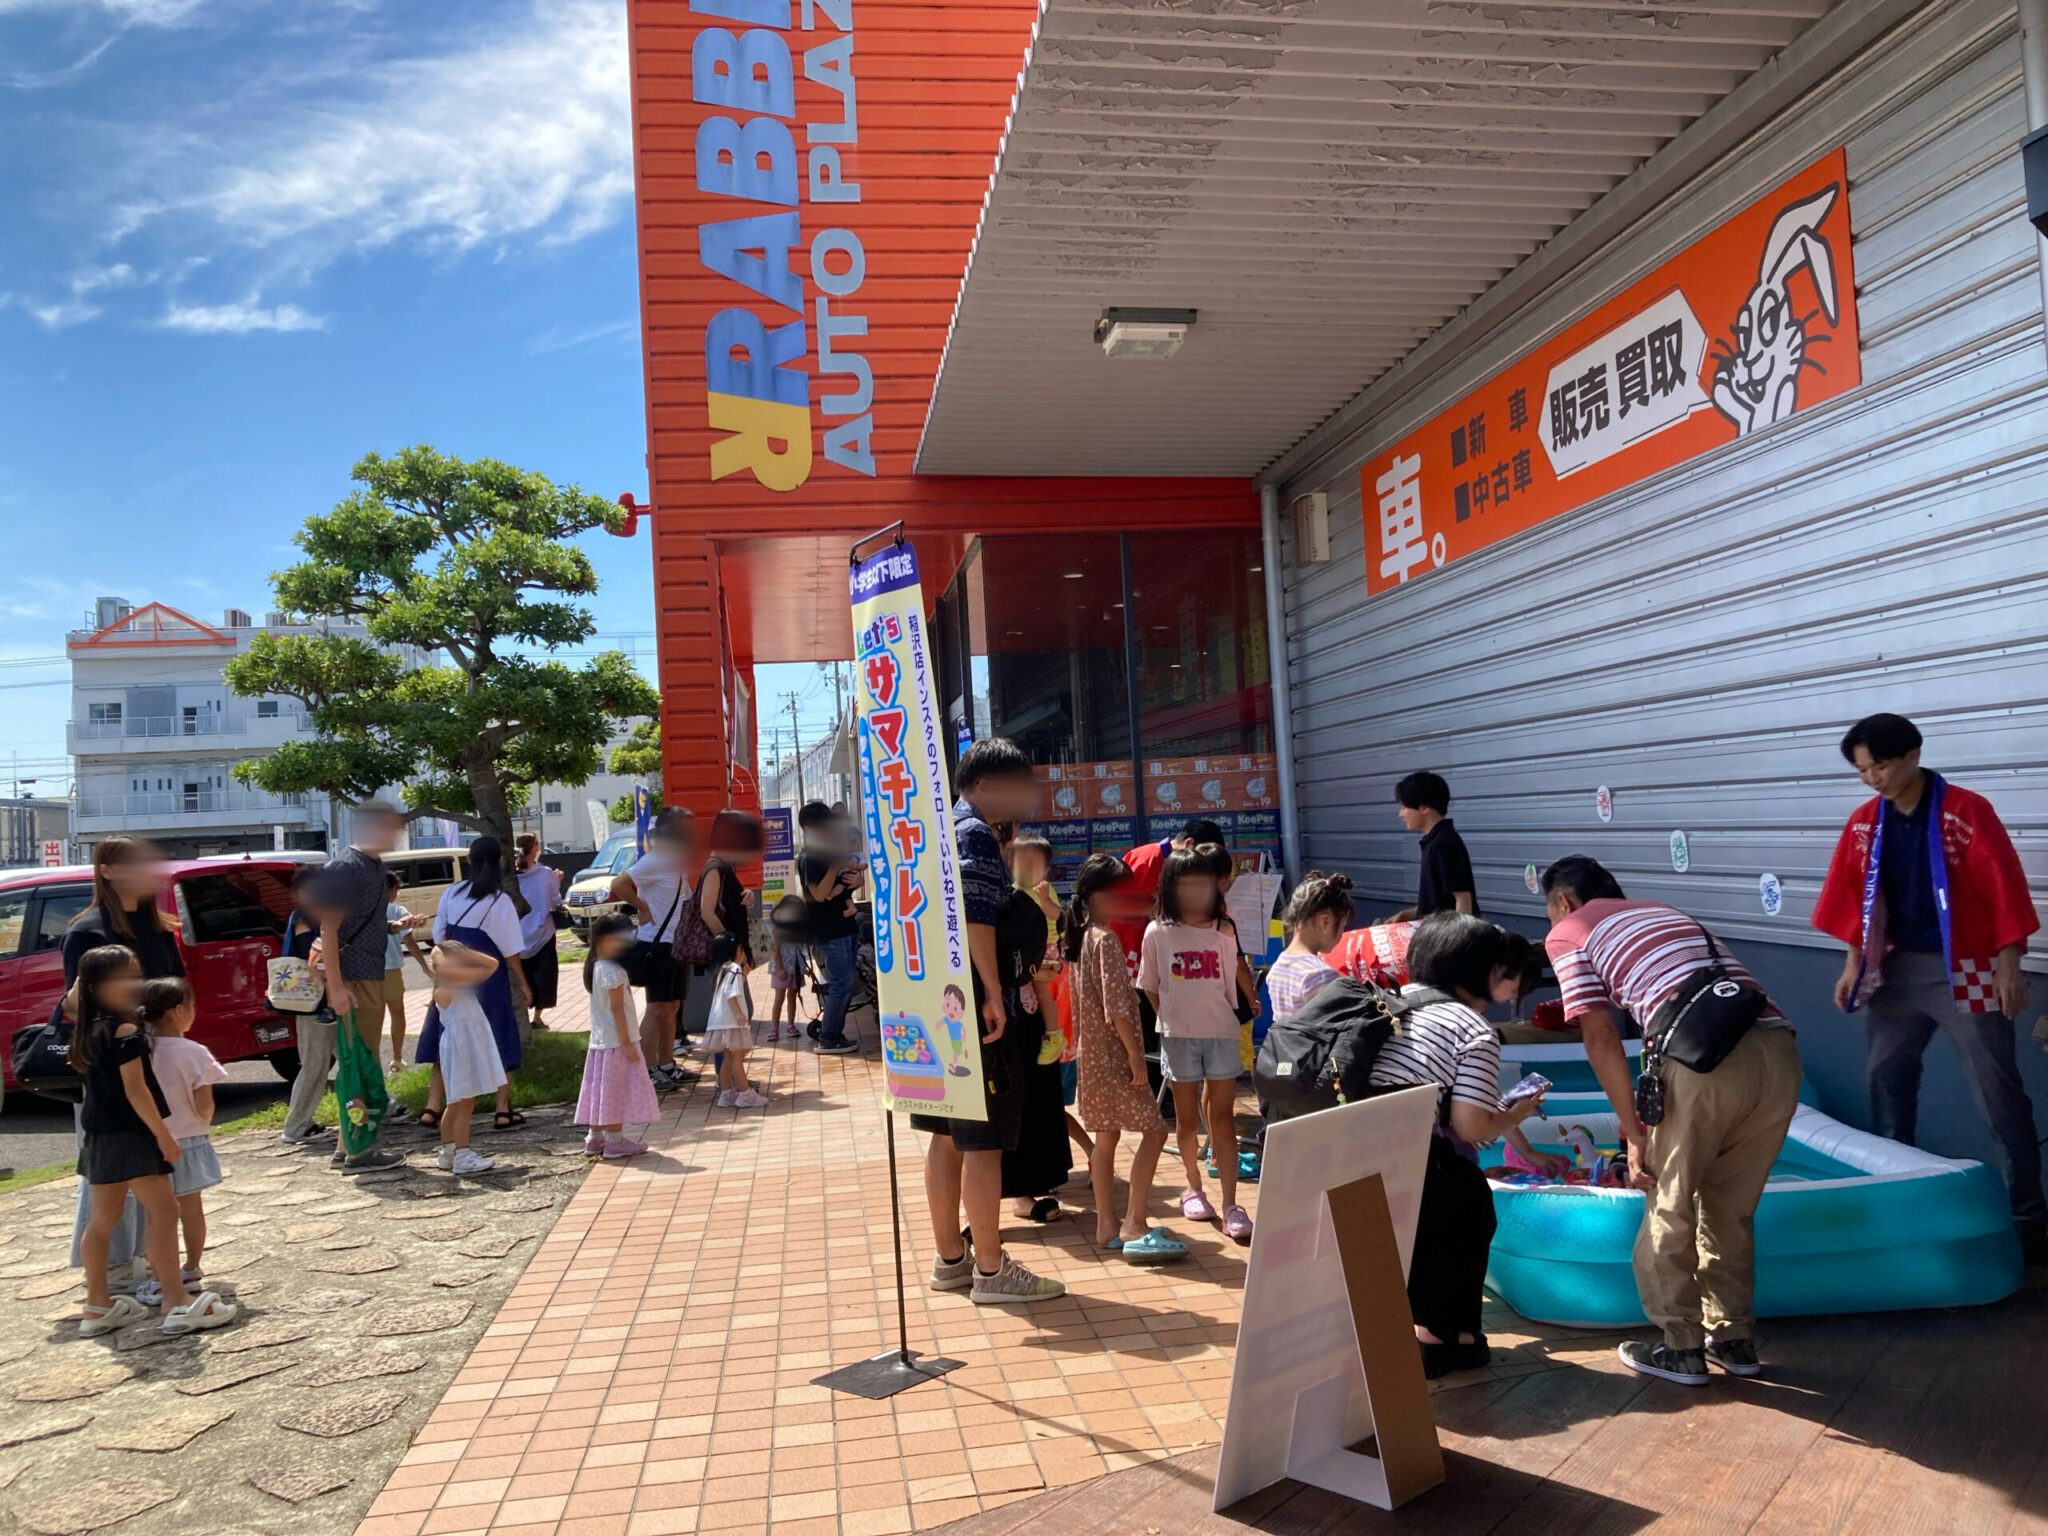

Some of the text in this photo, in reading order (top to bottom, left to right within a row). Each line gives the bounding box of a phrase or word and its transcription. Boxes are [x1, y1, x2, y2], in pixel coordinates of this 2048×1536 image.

[811, 227, 877, 478] AUTO
[1549, 317, 1688, 453] 販売 買取
[1472, 447, 1534, 516] 中古車
[856, 613, 902, 657] Let's
[1170, 802, 1182, 811] 19
[1215, 800, 1226, 809] 19
[1260, 797, 1271, 806] 19
[1069, 807, 1081, 816] 19
[1115, 804, 1126, 813] 19
[1237, 814, 1275, 825] KeePer
[1048, 824, 1087, 836] KeePer
[1092, 821, 1131, 833] KeePer
[898, 1100, 955, 1113] イラストはイメージです
